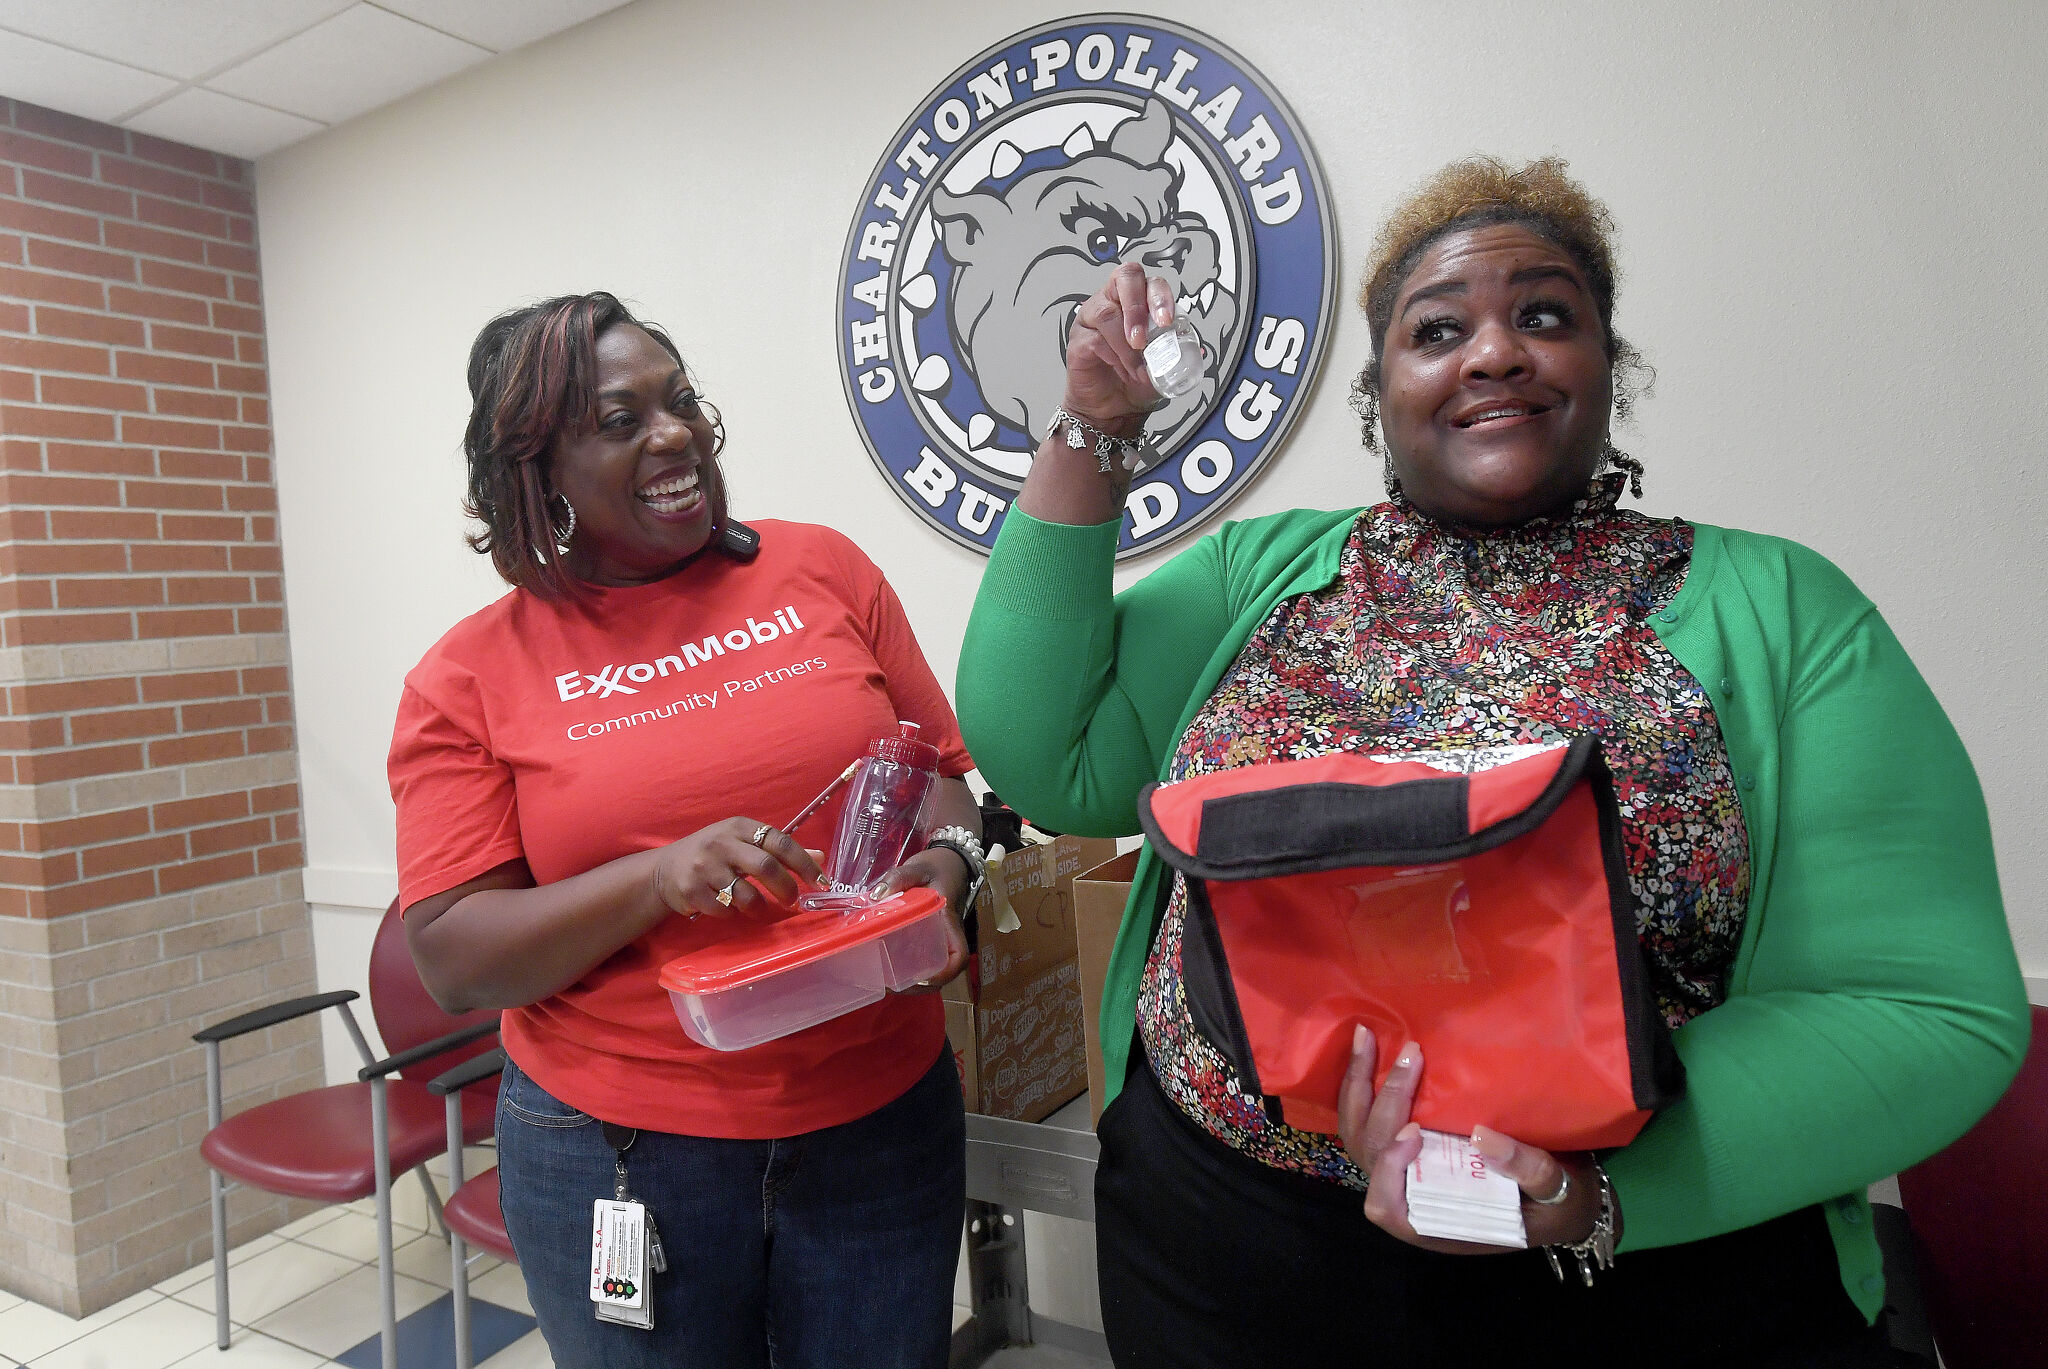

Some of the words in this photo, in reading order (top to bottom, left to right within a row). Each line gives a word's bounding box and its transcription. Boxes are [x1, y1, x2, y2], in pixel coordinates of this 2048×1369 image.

[903, 315, 1305, 539] BUDOGS
[554, 605, 805, 703] ExxonMobil
[567, 689, 718, 741] Community
[726, 655, 828, 700] Partners
[1469, 1153, 1487, 1181] YOU
